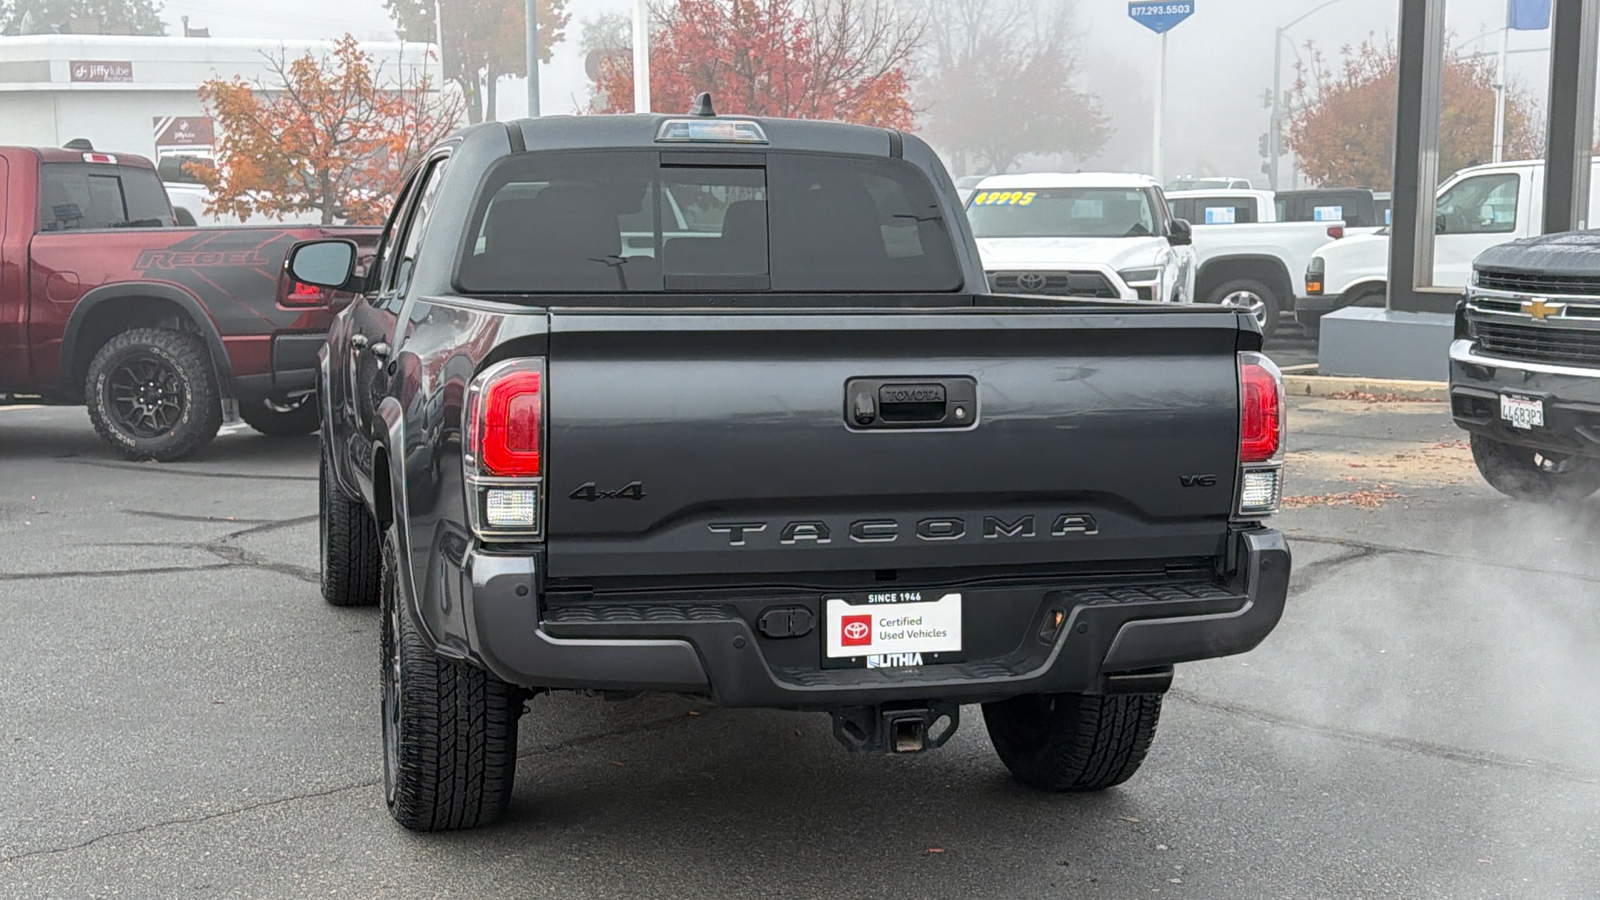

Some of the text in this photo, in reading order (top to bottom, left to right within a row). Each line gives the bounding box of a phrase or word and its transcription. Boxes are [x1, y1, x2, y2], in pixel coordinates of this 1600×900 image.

[1131, 5, 1190, 16] 877.293.5503
[975, 190, 1037, 206] 49995
[134, 249, 270, 270] REBEL
[886, 389, 943, 402] TOYOTA
[1179, 473, 1217, 488] V6
[707, 512, 1099, 546] TACOMA
[868, 592, 922, 603] SINCE 1946
[879, 616, 923, 628] Certified
[879, 628, 948, 641] Used Vehicles
[881, 652, 924, 668] LITHIA
